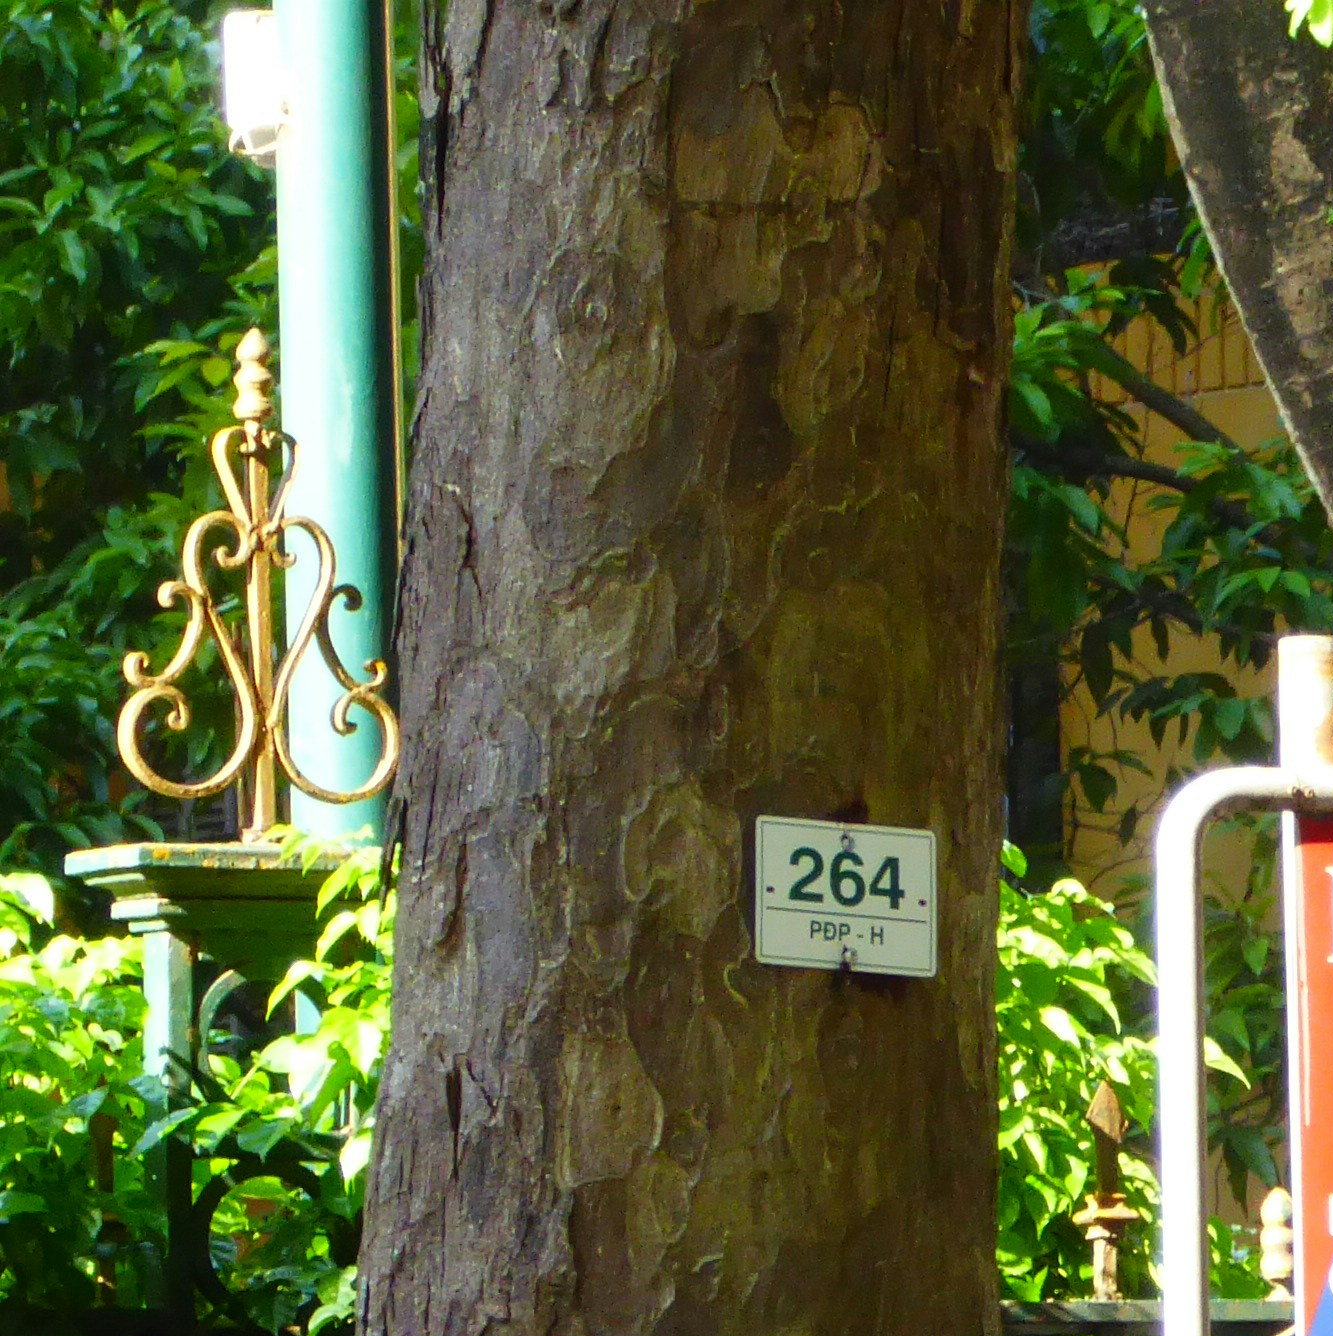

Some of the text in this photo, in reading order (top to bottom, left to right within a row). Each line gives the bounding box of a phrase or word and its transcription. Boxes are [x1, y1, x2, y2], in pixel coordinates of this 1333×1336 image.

[789, 847, 905, 910] 264
[810, 921, 850, 942] PĐP
[871, 927, 884, 945] H
